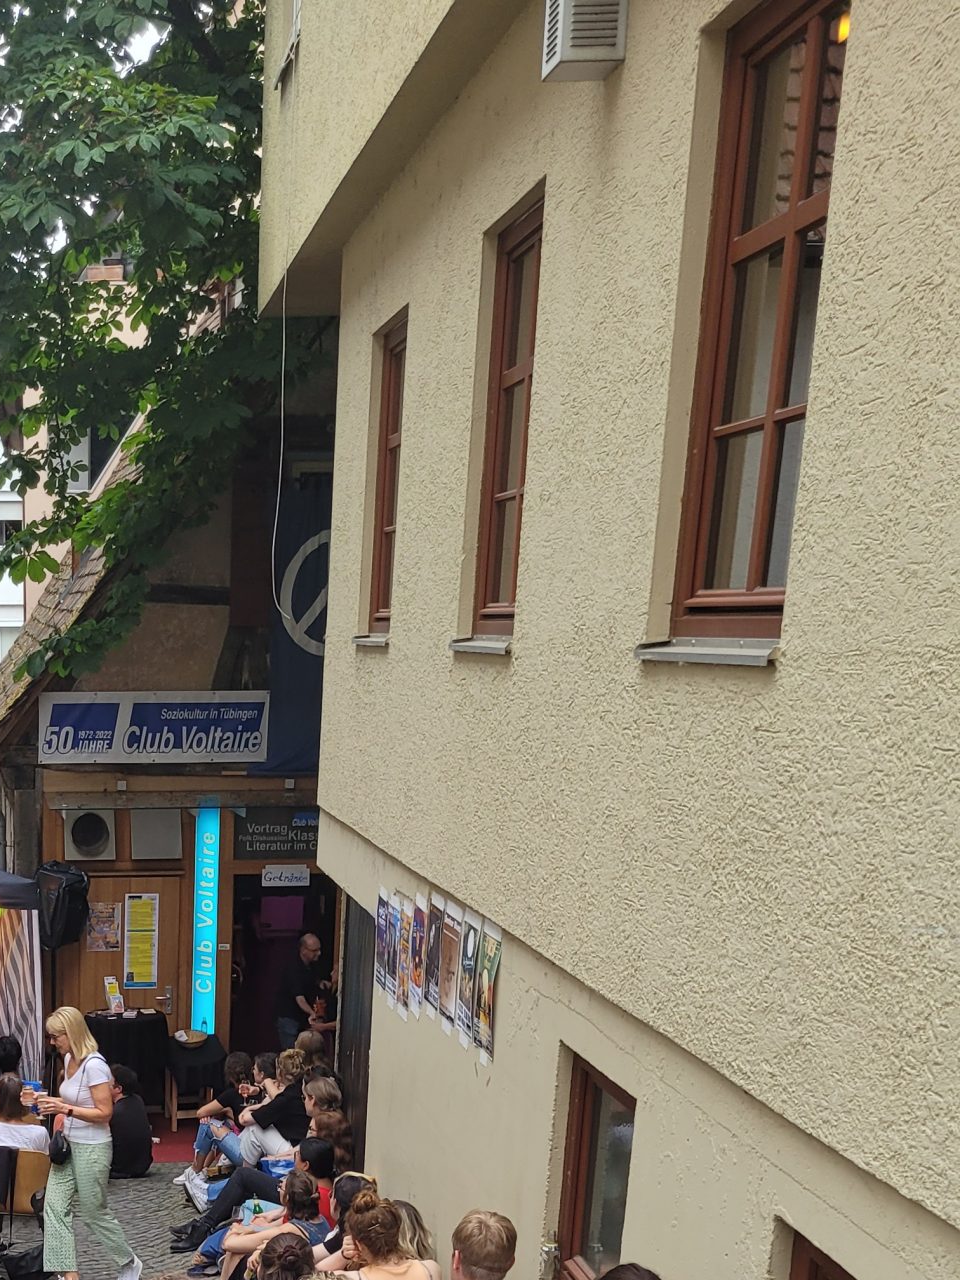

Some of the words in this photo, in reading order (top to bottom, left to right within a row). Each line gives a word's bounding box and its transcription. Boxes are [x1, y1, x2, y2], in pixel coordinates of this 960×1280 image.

[160, 708, 208, 720] Soziokultur
[219, 708, 258, 721] Tübingen
[42, 726, 74, 754] 50
[78, 730, 113, 739] 1972-2022
[122, 726, 174, 754] Club
[180, 725, 262, 754] Voltaire
[75, 740, 110, 753] JAHRE
[247, 823, 288, 835] Vortrag
[246, 841, 293, 851] Literatur
[294, 842, 306, 850] im
[196, 832, 216, 928] Voltaire
[195, 940, 213, 994] Club
